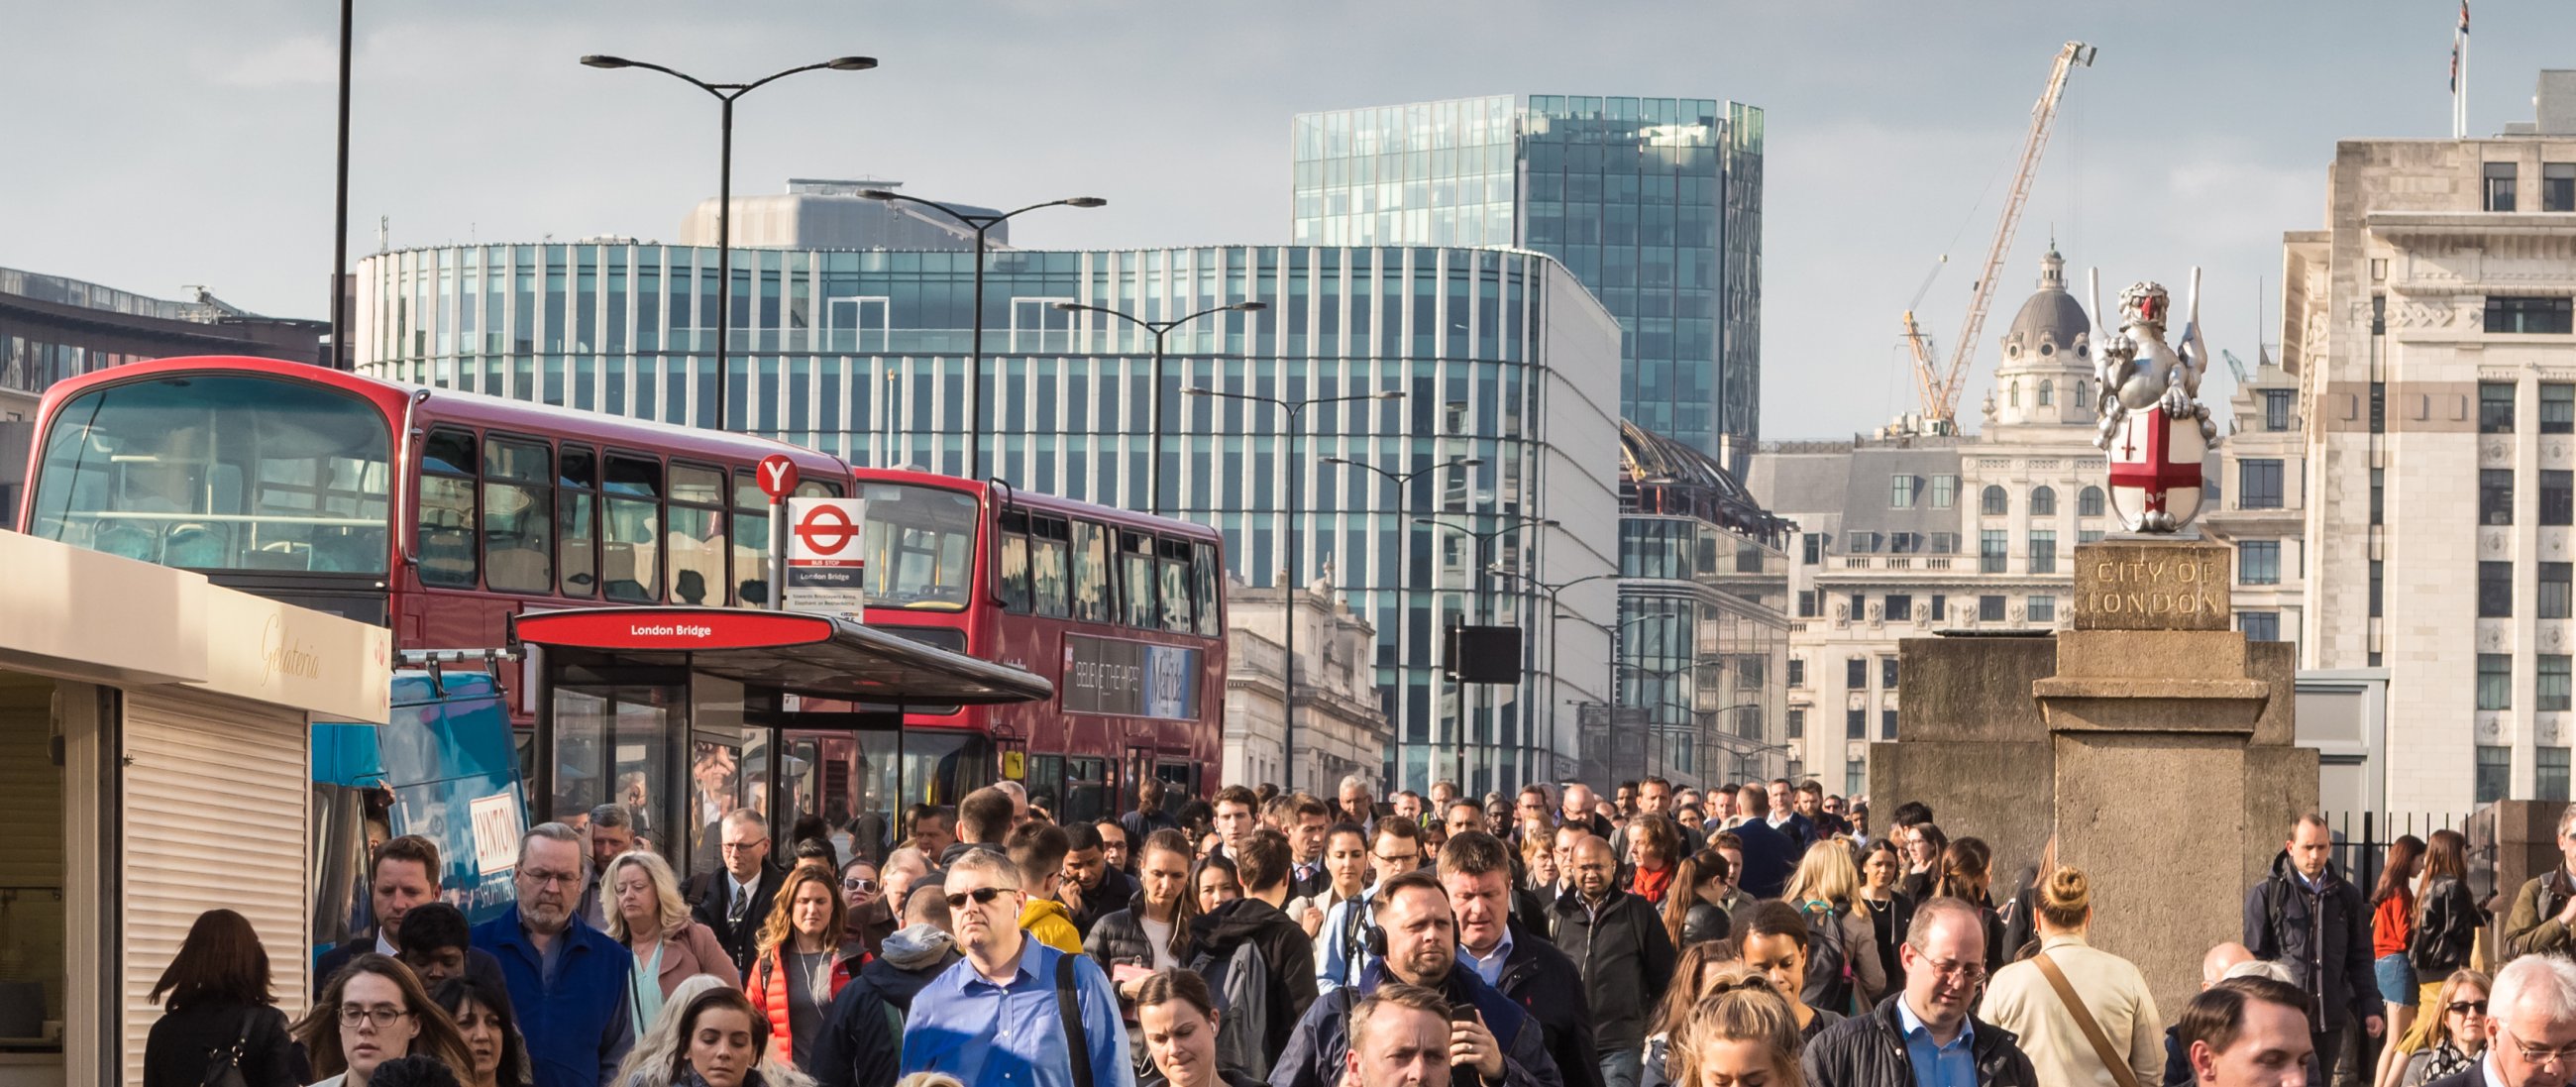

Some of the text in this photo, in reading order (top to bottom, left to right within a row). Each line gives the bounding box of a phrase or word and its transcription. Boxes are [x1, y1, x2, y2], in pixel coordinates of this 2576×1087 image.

[764, 461, 790, 492] Y
[2097, 560, 2214, 583] CITY OF
[2090, 592, 2218, 613] LONDON
[631, 625, 711, 638] London Bridge
[262, 613, 319, 687] Gelateria
[1150, 655, 1183, 705] Matilda
[475, 807, 517, 861] LYNTON
